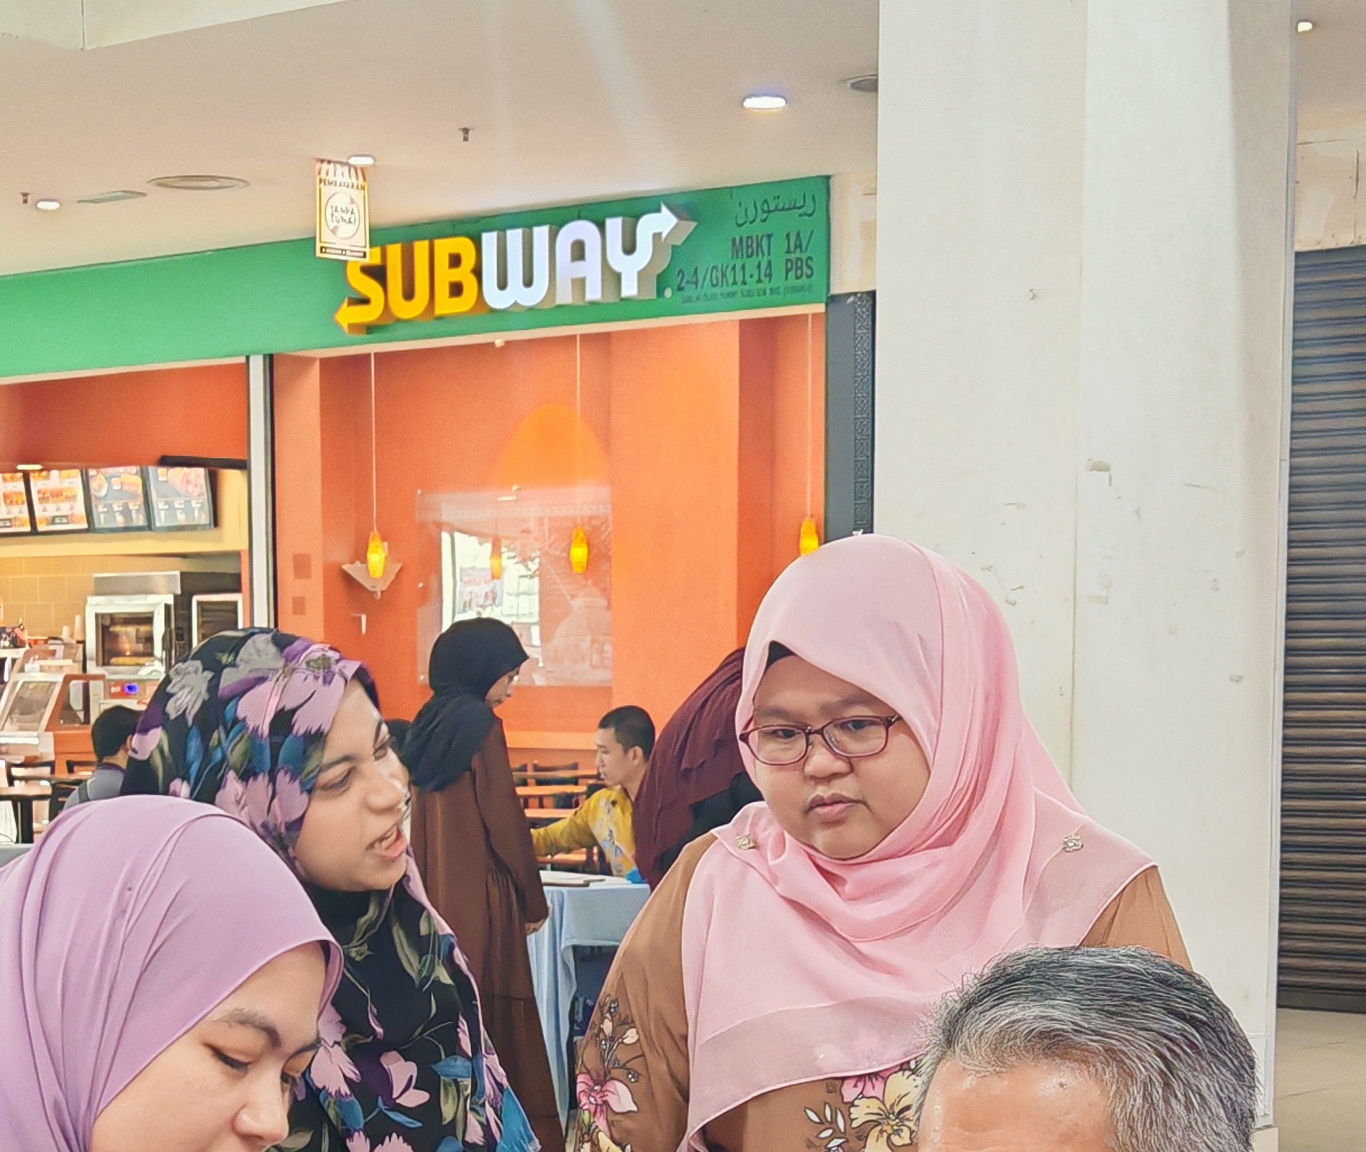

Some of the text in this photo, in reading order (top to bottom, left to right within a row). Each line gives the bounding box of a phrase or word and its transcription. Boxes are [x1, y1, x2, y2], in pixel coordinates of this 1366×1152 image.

[731, 228, 815, 259] MBKT 1A/
[334, 201, 679, 333] SUBWAY
[785, 256, 815, 281] PBS
